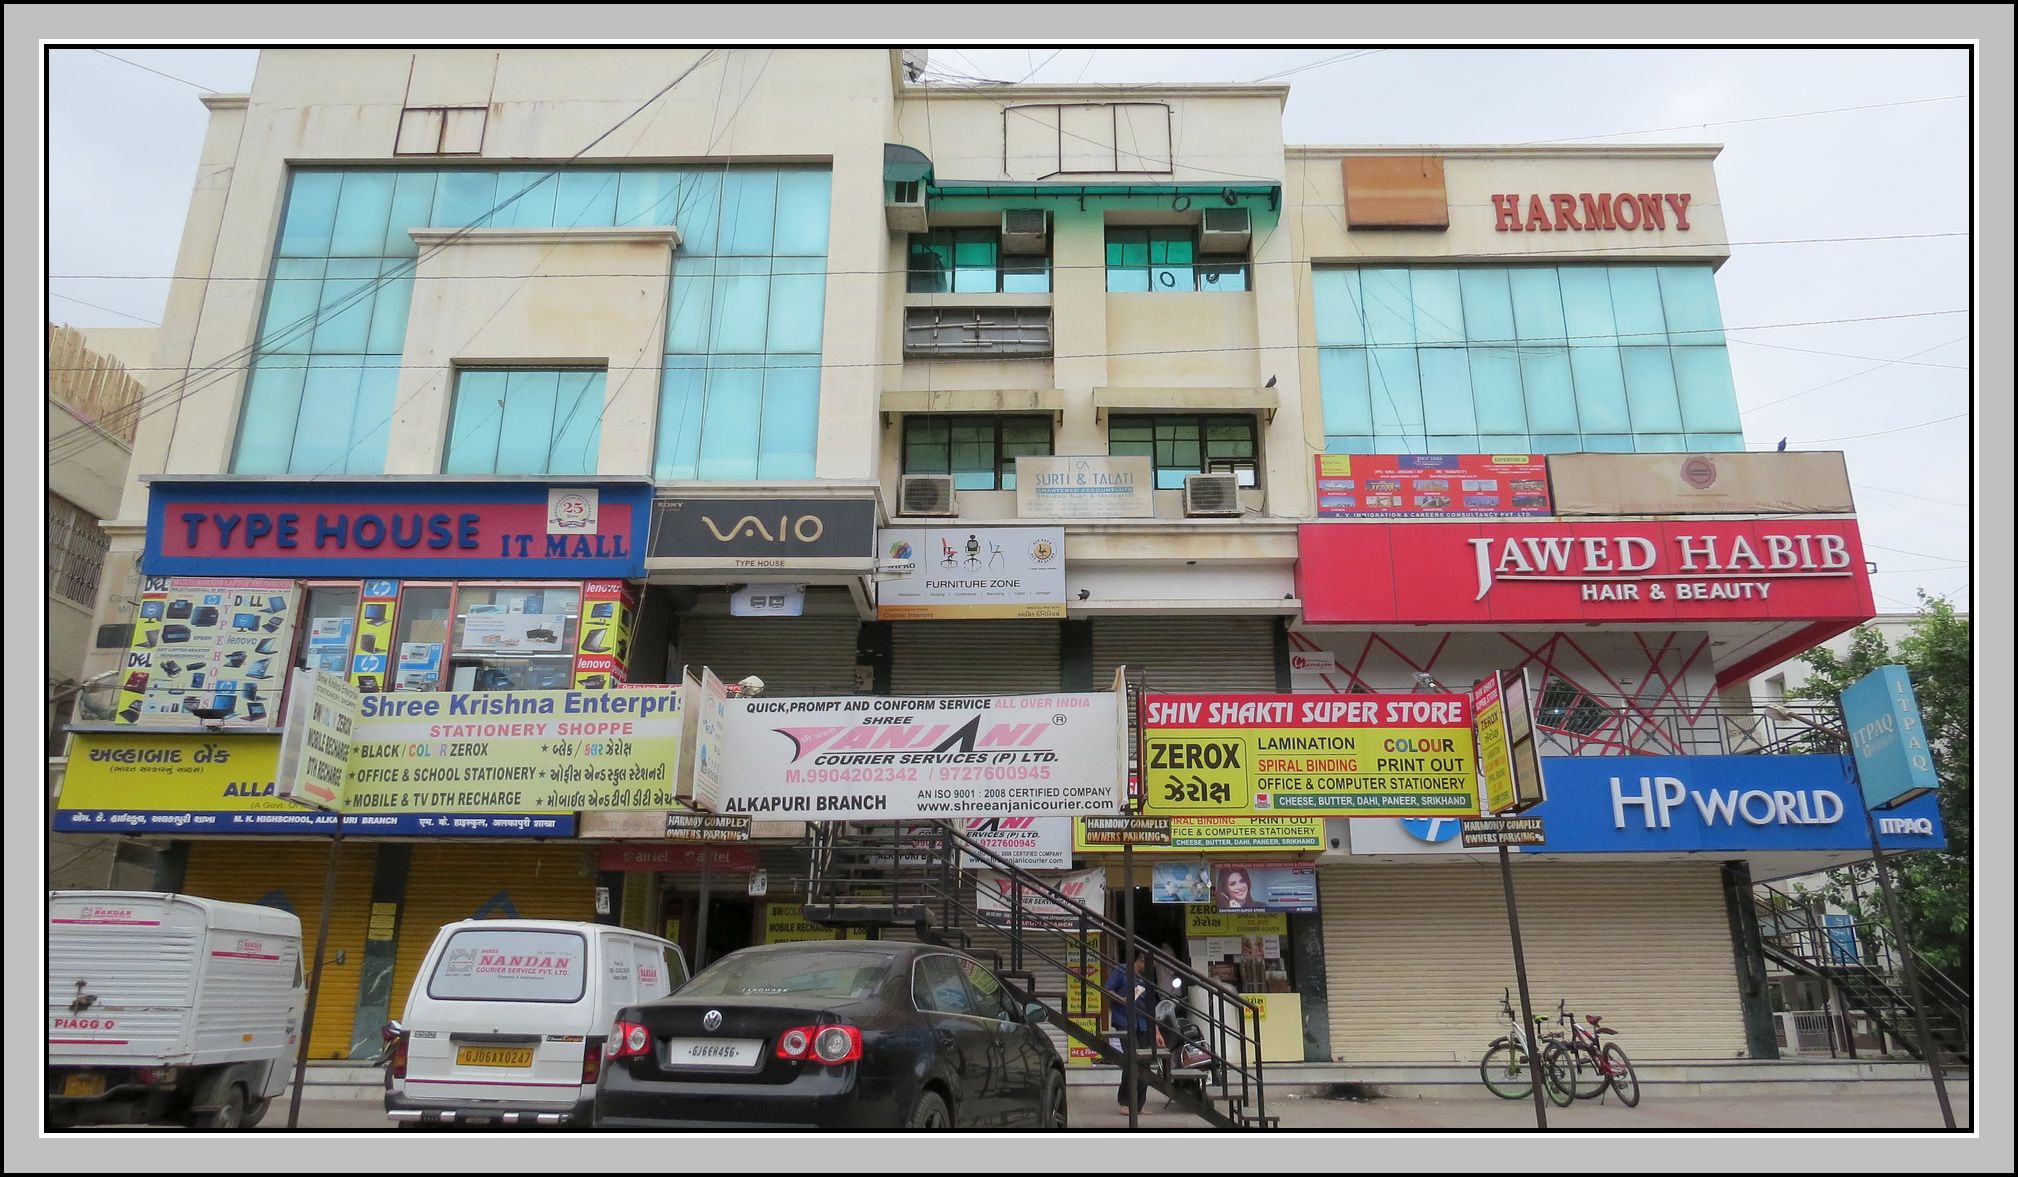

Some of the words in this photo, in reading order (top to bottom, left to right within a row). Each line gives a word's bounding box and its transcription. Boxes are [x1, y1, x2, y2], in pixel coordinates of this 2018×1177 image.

[1491, 193, 1691, 231] HARMONY
[1035, 473, 1070, 486] SURTI
[1076, 473, 1087, 485] &
[1094, 473, 1133, 485] TALATI
[563, 502, 584, 513] 25
[181, 512, 299, 548] TYPE
[315, 512, 480, 549] HOUSE
[501, 534, 533, 558] IT
[545, 534, 628, 558] MALL
[702, 515, 824, 543] VAIO
[1468, 536, 1658, 601] JAWED
[1675, 534, 1852, 571] HABIB
[926, 579, 987, 589] FURNITURE
[990, 579, 1021, 588] ZONE
[1581, 584, 1640, 601] HAIR
[1650, 583, 1666, 600] &
[1675, 582, 1771, 600] BEAUTY
[226, 635, 257, 645] lenovo
[577, 658, 611, 669] lenovo
[361, 695, 440, 718] Shree
[449, 693, 554, 716] Krishna
[844, 701, 870, 712] AND
[873, 700, 935, 711] CONFORM
[939, 699, 991, 710] SERVICE
[994, 699, 1016, 709] ALL
[1020, 698, 1051, 709] OVER
[1056, 697, 1090, 708] INDIA
[1148, 702, 1202, 725] SHIV
[1208, 702, 1294, 725] SHAKTI
[1302, 701, 1378, 725] SUPER
[1386, 701, 1461, 725] STORE
[862, 716, 913, 725] SHREE
[1481, 711, 1499, 731] ZEROX
[430, 723, 547, 738] STATIONERY
[558, 722, 633, 736] SHOPPE
[1852, 713, 1894, 749] ITPAQ
[361, 744, 400, 758] BLACK
[450, 743, 488, 757] ZEROX
[552, 738, 573, 757] બ્લેક
[606, 738, 632, 757] ઝેરોક્ષ
[1258, 737, 1355, 750] LAMINATION
[1384, 738, 1455, 753] COLOUR
[814, 754, 895, 766] COURIER
[899, 753, 988, 764] SERVICES
[992, 753, 1017, 765] (P)
[1021, 752, 1059, 763] LTD.
[1150, 743, 1240, 769] ZEROX
[1258, 759, 1303, 772] SPIRAL
[1306, 759, 1357, 772] BINDING
[1377, 758, 1425, 772] PRINT
[1430, 758, 1464, 772] OUT
[357, 768, 399, 783] OFFICE
[402, 769, 410, 781] &
[414, 768, 460, 782] SCHOOL
[464, 767, 537, 781] STATIONERY
[786, 767, 918, 783] M.9904202342
[940, 765, 1051, 781] 9727600945
[1164, 775, 1231, 804] ઝેરોક્ષ
[1258, 778, 1302, 790] OFFICE
[1305, 778, 1314, 790] &
[1318, 777, 1386, 790] COMPUTER
[1390, 777, 1465, 790] STATIONERY
[353, 793, 398, 807] MOBILE
[401, 793, 409, 806] &
[414, 793, 428, 806] TV
[431, 792, 456, 806] DTH
[459, 791, 522, 806] RECHARGE
[918, 790, 932, 799] AN
[934, 790, 951, 799] ISO
[954, 789, 975, 798] 9001
[984, 789, 1006, 798] 2008
[1008, 788, 1059, 798] CERTIFIED
[1064, 787, 1112, 797] COMPANY
[725, 797, 810, 812] ALKAPURI
[816, 795, 887, 811] BRANCH
[917, 799, 1114, 813] www.shreeanjanicourier.com
[1279, 796, 1316, 807] CHEESE,
[1319, 796, 1355, 807] BUTTER,
[1357, 796, 1381, 807] DAHI,
[1382, 796, 1419, 807] PANEER,
[1421, 796, 1466, 806] SRIKHAND
[1609, 777, 1686, 829] HP
[1690, 788, 1844, 827] WORLD
[233, 815, 244, 823] M.
[256, 815, 314, 825] HIGHSCHOOL,
[362, 816, 398, 825] BRANCH
[704, 817, 750, 828] COMPLEX
[1087, 818, 1130, 830] HARMONY
[1130, 819, 1169, 829] COMPLEX
[1251, 817, 1288, 825] PRINT
[1290, 817, 1315, 825] OUT
[1463, 820, 1505, 832] HARMONY
[1506, 819, 1541, 830] COMPLEX
[1878, 817, 1934, 836] ITPAQ
[666, 829, 701, 839] OWNERS
[703, 830, 742, 841] PARKING
[1007, 831, 1020, 839] (P)
[1087, 831, 1120, 841] OWNERS
[1122, 831, 1160, 841] PARKING
[1196, 828, 1204, 836] &
[1207, 827, 1257, 836] COMPUTER
[1260, 827, 1316, 836] STATIONERY
[1465, 833, 1496, 844] OWNERS
[1499, 832, 1535, 843] PARKING
[980, 839, 1036, 848] 9727600945
[1176, 839, 1204, 847] CHEESE,
[1205, 839, 1233, 847] BUTTER,
[1234, 839, 1251, 847] DAHI,
[636, 851, 669, 863] airtel
[769, 923, 796, 932] MOBILE
[796, 923, 833, 932] RECHARGE
[479, 955, 571, 968] NANDAN
[508, 967, 537, 975] SERVICE
[464, 1047, 531, 1065] GJ06AX0247
